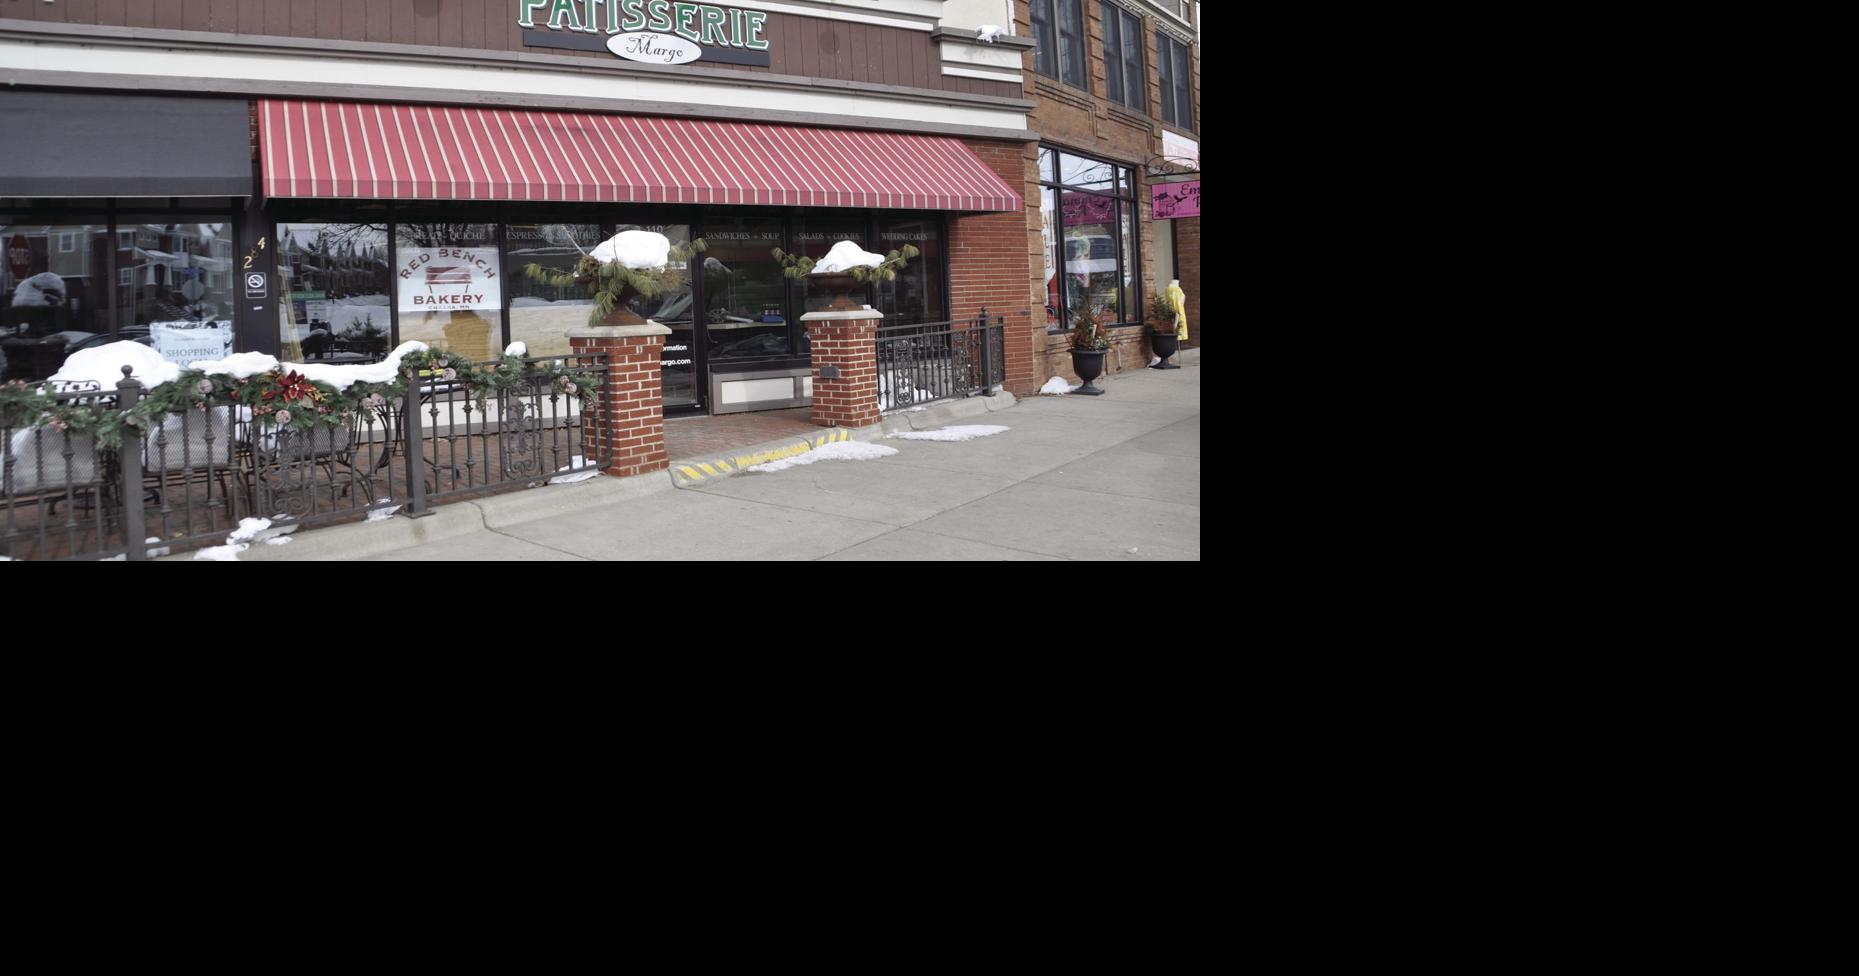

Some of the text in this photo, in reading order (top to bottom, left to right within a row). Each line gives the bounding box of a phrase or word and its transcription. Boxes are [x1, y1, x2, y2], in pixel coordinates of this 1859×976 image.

[518, 0, 769, 49] PATISSERIE
[626, 34, 684, 62] Margo
[705, 231, 779, 240] SANDWICHES SOUP
[798, 232, 824, 240] SALADS
[400, 248, 496, 280] RED BENCH
[413, 294, 484, 305] BAKERY
[166, 347, 219, 358] SHOPPING
[660, 359, 692, 367] argo.com
